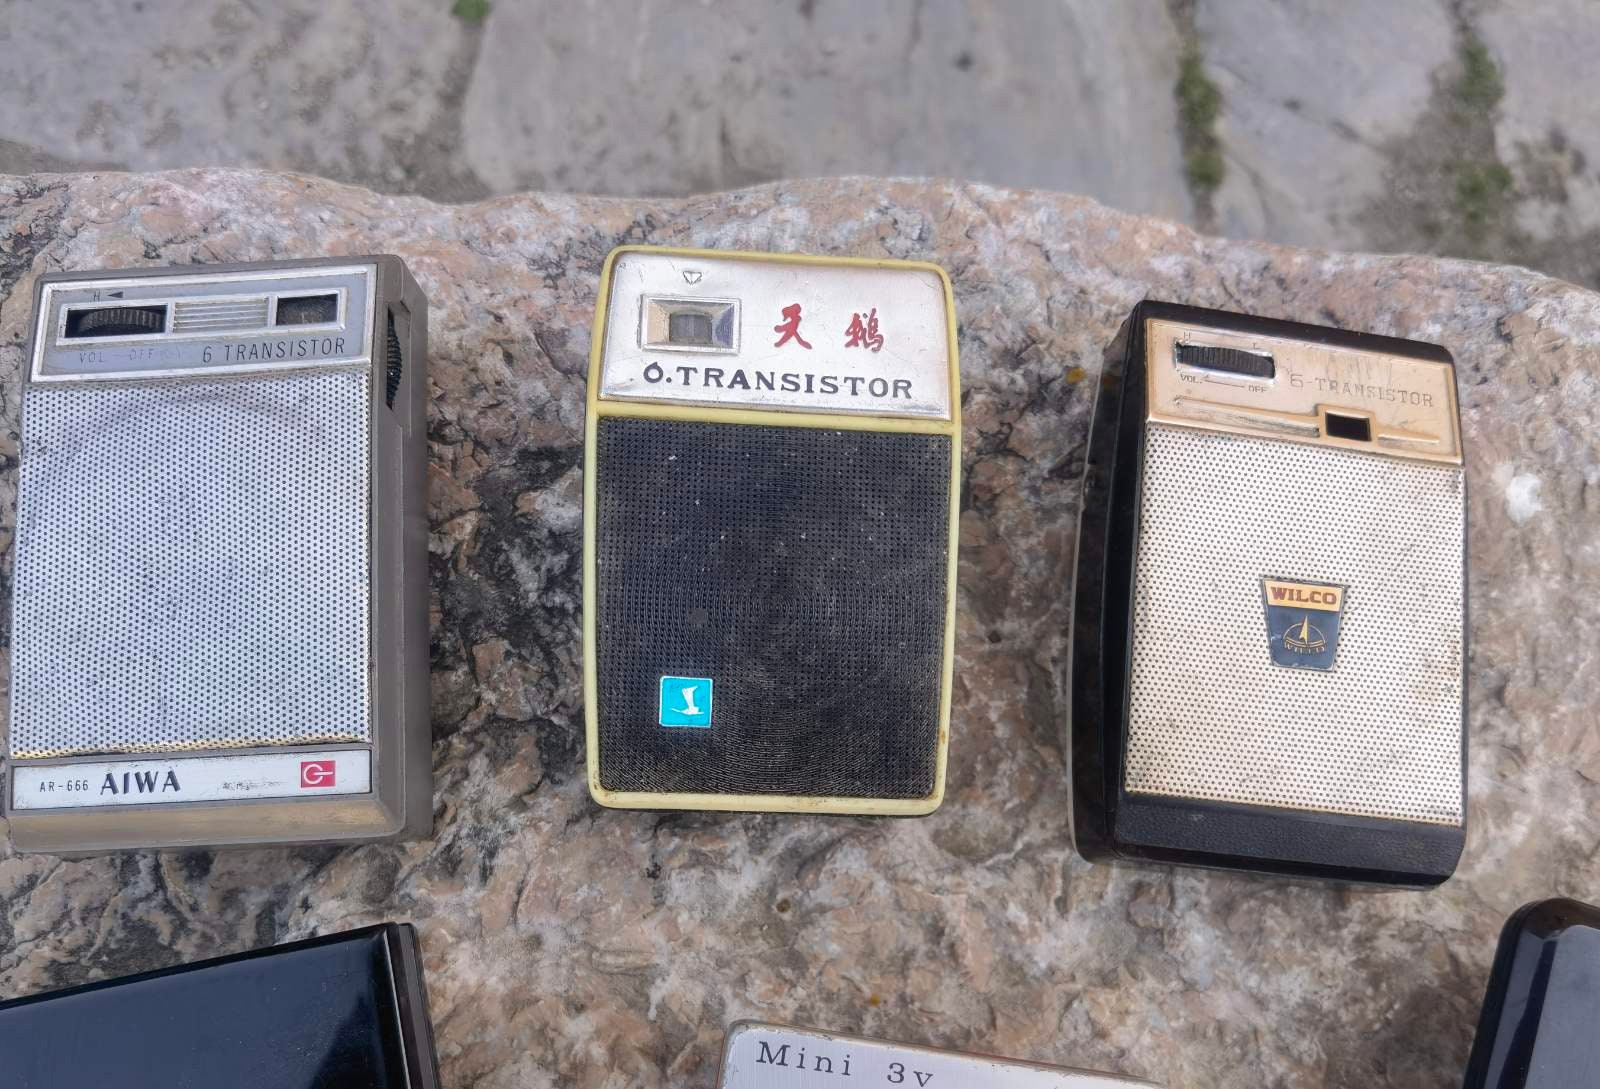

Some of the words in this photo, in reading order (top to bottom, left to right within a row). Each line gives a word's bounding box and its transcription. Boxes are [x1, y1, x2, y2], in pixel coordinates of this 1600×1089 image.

[202, 340, 212, 364] 6
[224, 337, 346, 362] TRANSISTOR
[1270, 586, 1337, 605] WILCO
[39, 779, 90, 793] AR-666
[100, 769, 182, 796] AIWA
[756, 1041, 851, 1076] Mini
